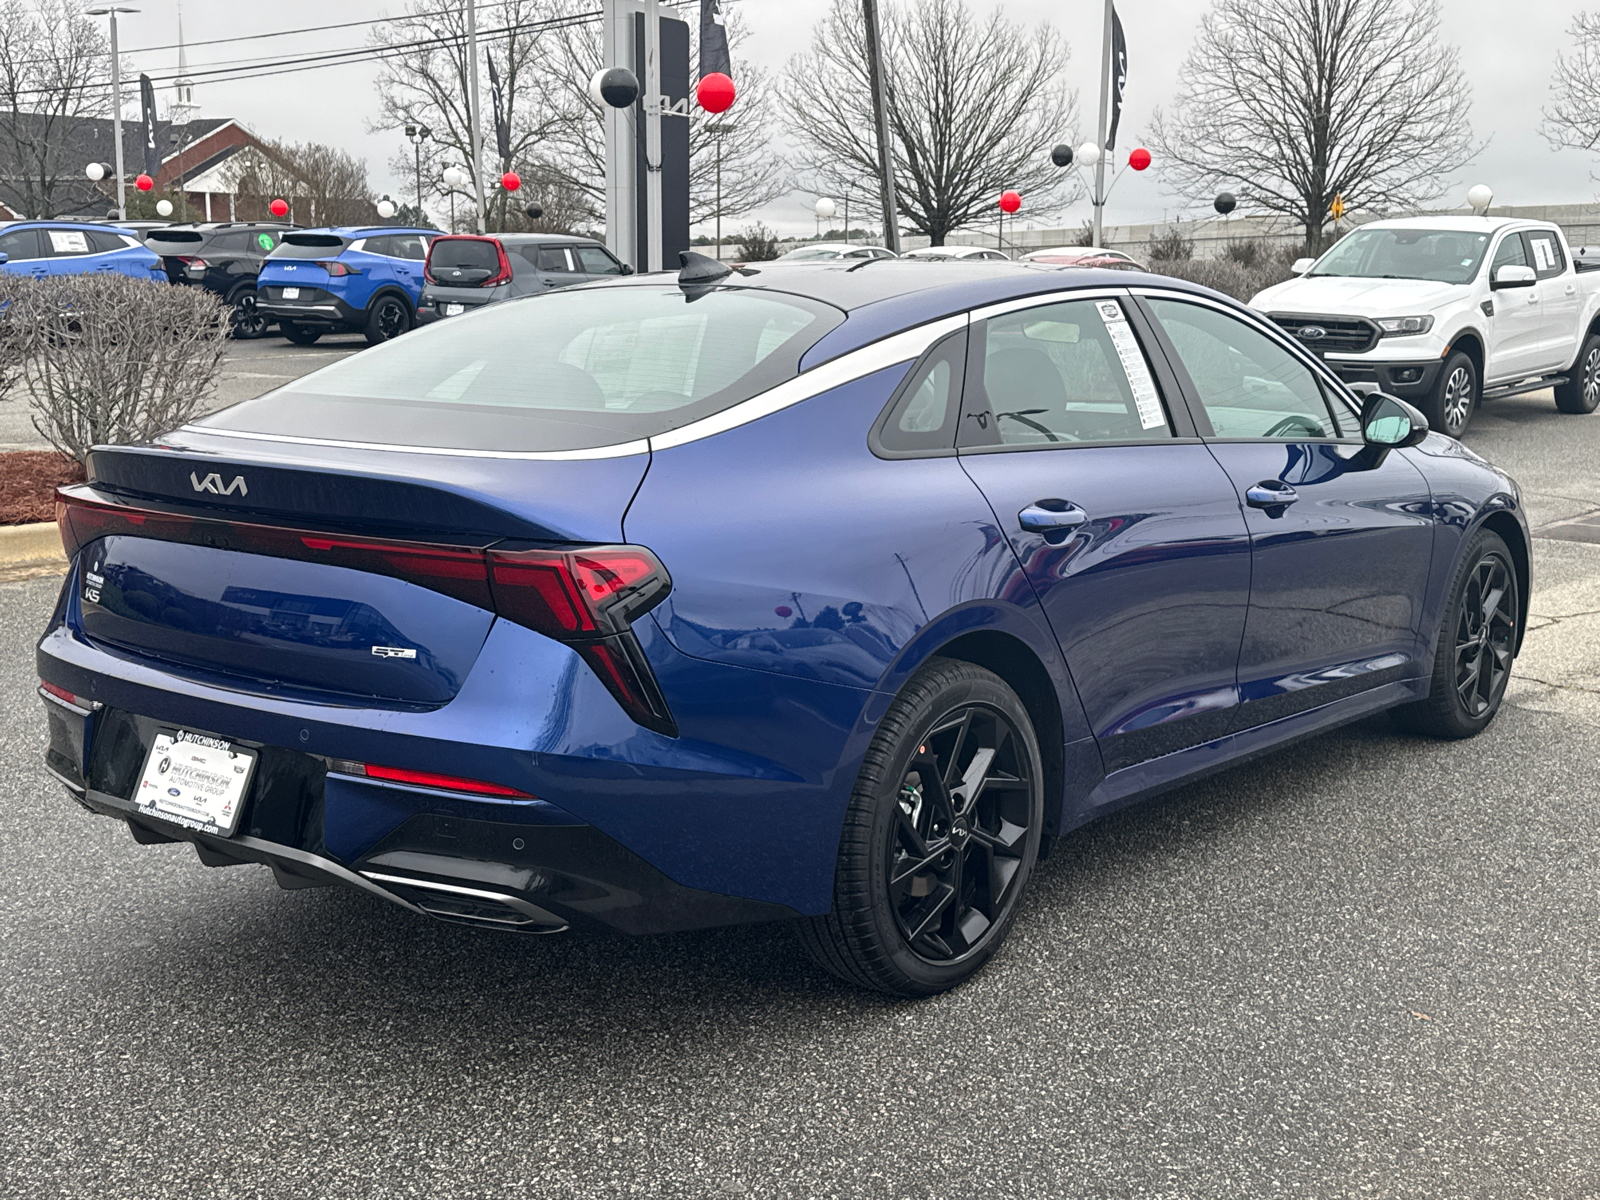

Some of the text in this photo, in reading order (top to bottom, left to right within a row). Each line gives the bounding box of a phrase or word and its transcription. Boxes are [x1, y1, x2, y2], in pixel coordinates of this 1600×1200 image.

[190, 471, 248, 497] KIA
[85, 587, 100, 603] K5
[184, 732, 231, 751] HUTCHINSON
[168, 776, 225, 797] AUTOMOTIVE GROUP
[171, 762, 233, 789] HUTCHINSON
[138, 803, 219, 835] Hutchinsonautogroup.com
